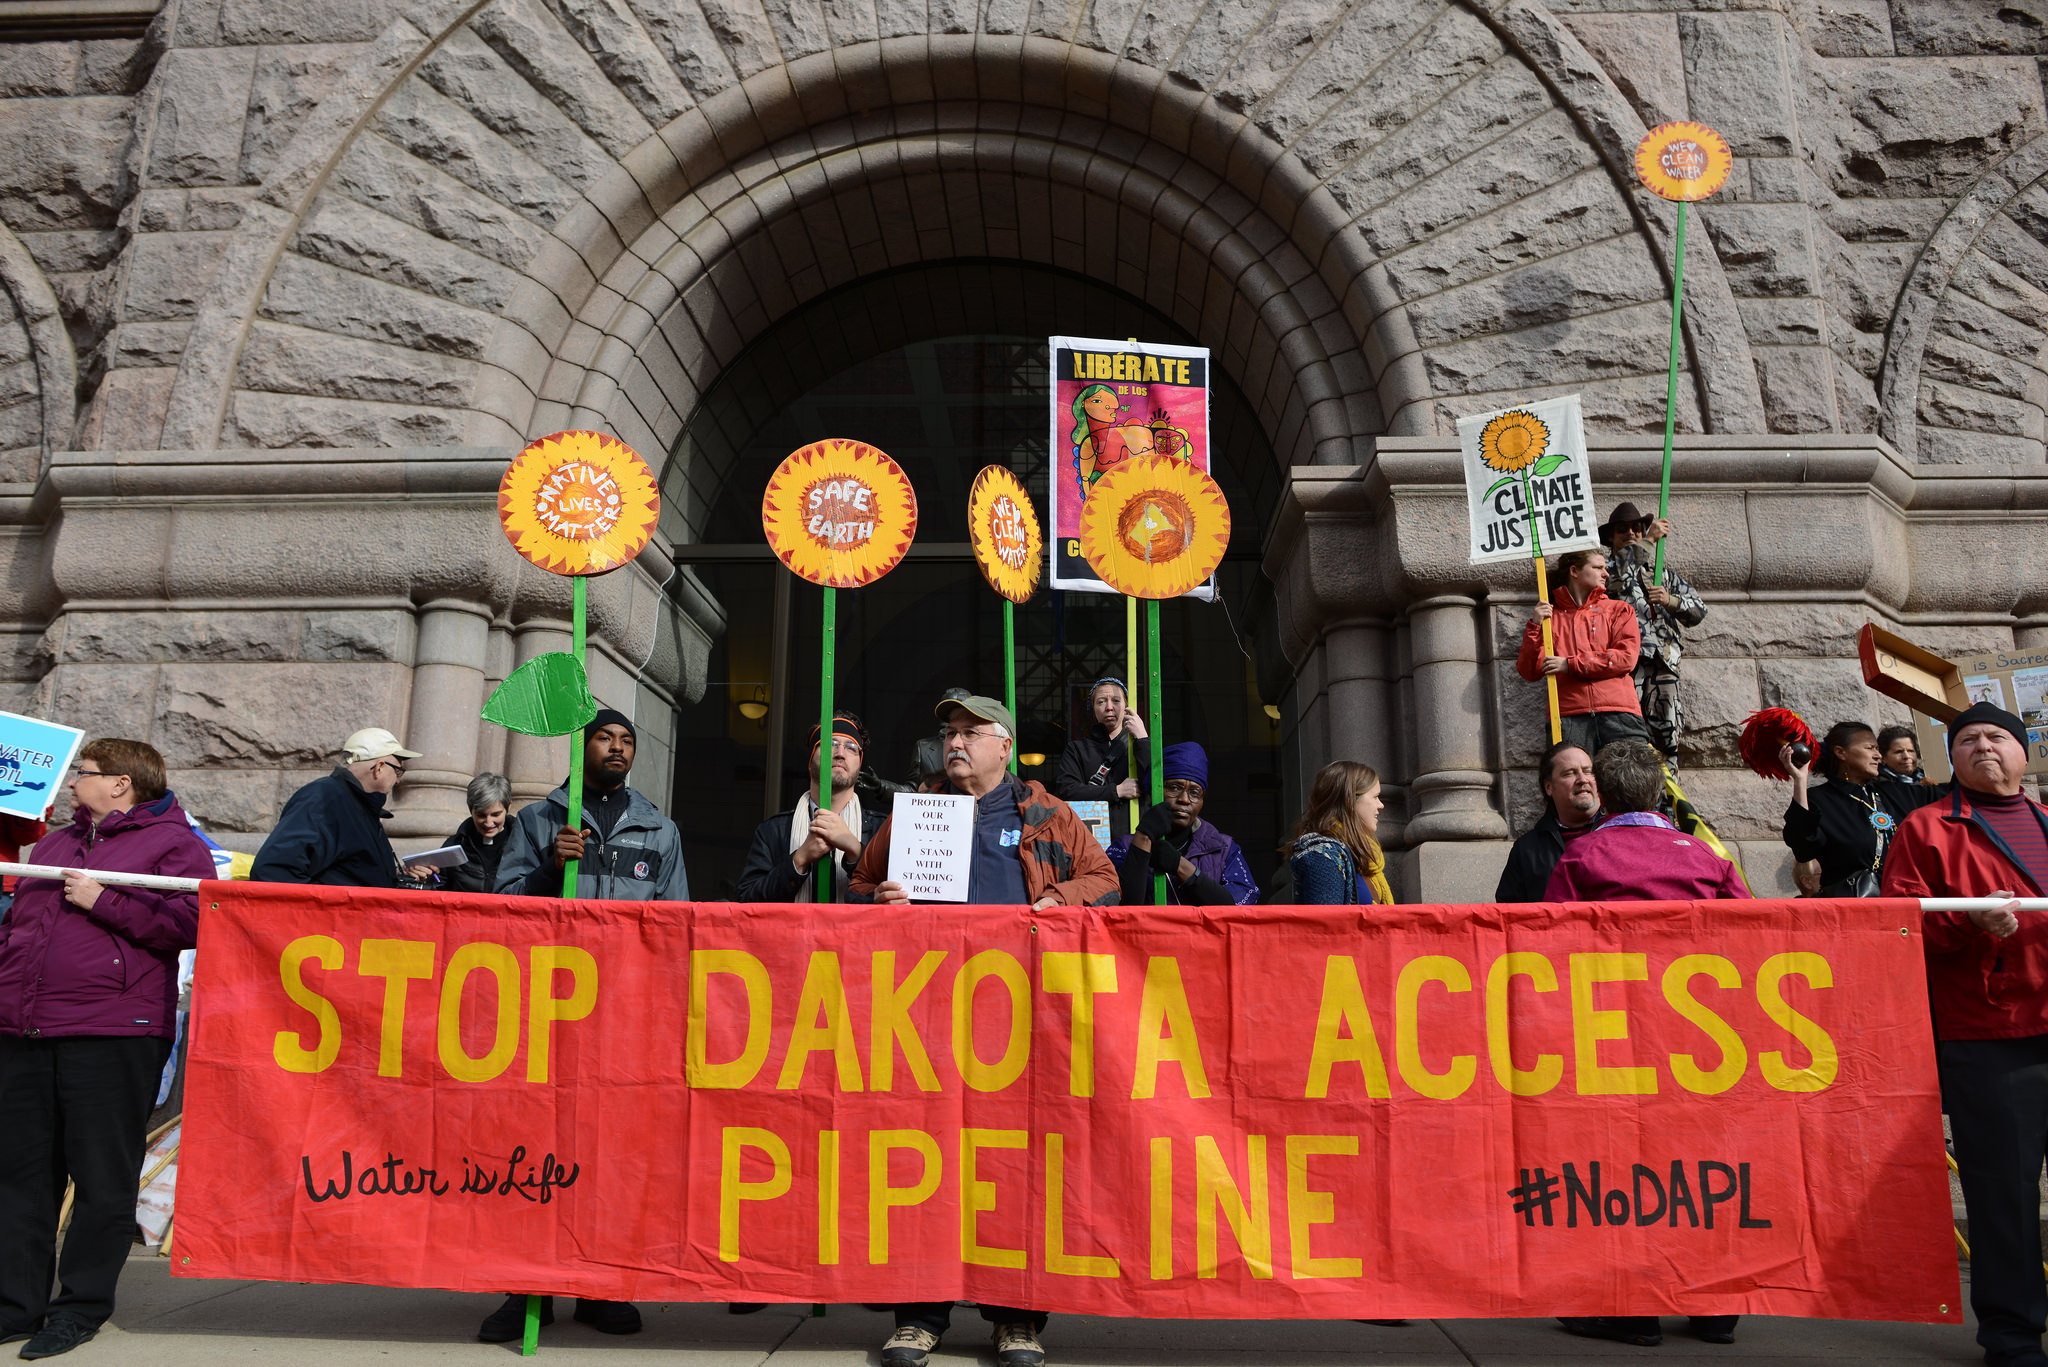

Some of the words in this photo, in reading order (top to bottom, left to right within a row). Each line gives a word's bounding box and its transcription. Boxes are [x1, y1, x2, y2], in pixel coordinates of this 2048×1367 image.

[1668, 142, 1687, 152] WE
[1662, 152, 1704, 166] CLEAN
[1666, 166, 1702, 179] WATER
[1074, 352, 1191, 385] LIBÉRATE
[1118, 385, 1130, 396] DE
[1131, 386, 1148, 397] LOS
[538, 462, 617, 503] NATIVE
[559, 497, 603, 513] LIVES
[809, 480, 872, 512] SAFE
[1494, 473, 1585, 516] CLIMATE
[992, 496, 1012, 518] WE
[539, 506, 622, 539] MATTER
[809, 514, 874, 544] EARTH
[993, 518, 1025, 543] CLEAN
[1480, 505, 1588, 552] JUSTICE
[998, 540, 1027, 568] WATER
[1973, 660, 1987, 672] is
[911, 798, 957, 808] PROTECT
[922, 811, 943, 820] OUR
[914, 823, 950, 832] WATER
[906, 847, 911, 856] I
[920, 848, 953, 857] STAND
[915, 860, 942, 869] WITH
[902, 872, 953, 882] STANDING
[912, 885, 941, 894] ROCK
[273, 934, 599, 1083] STOP
[686, 949, 1212, 1099] DAKOTA
[1304, 951, 1839, 1101] ACCESS
[302, 1150, 448, 1203] Water
[459, 1157, 498, 1195] is
[499, 1145, 580, 1204] Life
[719, 1126, 1363, 1280] PIPELINE
[1507, 1159, 1772, 1230] #NoDAPL
